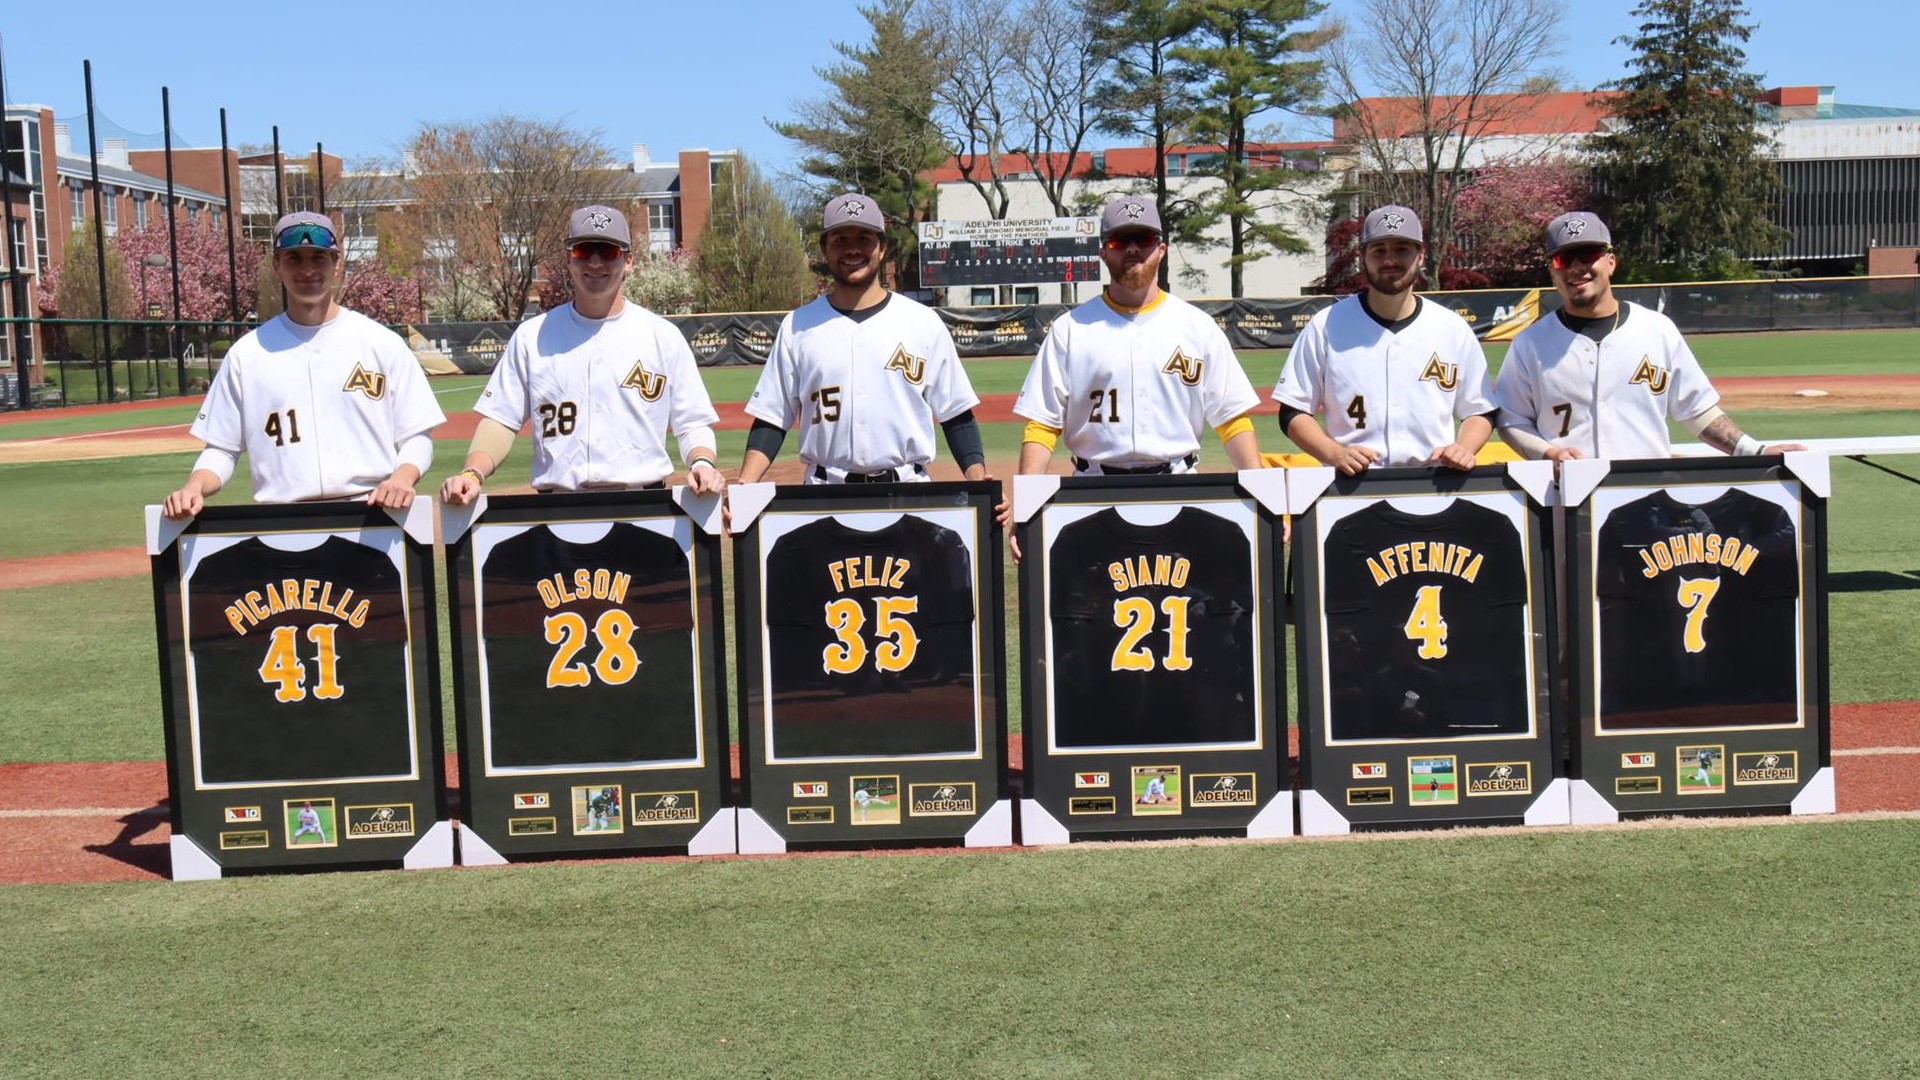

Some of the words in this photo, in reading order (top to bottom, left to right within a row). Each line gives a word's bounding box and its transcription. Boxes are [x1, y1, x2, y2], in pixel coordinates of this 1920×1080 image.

[965, 220, 1001, 228] ADELPHI
[1003, 219, 1052, 227] UNIVERSITY
[1029, 238, 1047, 246] OUT
[970, 240, 991, 248] BALL
[995, 239, 1024, 247] STRIKE
[467, 344, 508, 353] SAMBITO
[995, 327, 1025, 335] CLARK
[342, 361, 386, 401] AU
[620, 359, 667, 402] AU
[885, 342, 927, 386] AU
[1162, 345, 1205, 386] AU
[1418, 351, 1459, 392] AU
[1629, 354, 1670, 395] AU
[539, 400, 577, 438] 28
[1088, 388, 1121, 423] 21
[1347, 394, 1367, 429] 4
[1552, 402, 1573, 437] 7
[264, 408, 301, 447] 41
[828, 555, 911, 593] FELIZ
[1108, 554, 1191, 592] SIANO
[1366, 541, 1484, 587] AFFENITA
[1639, 532, 1760, 579] JOHNSON
[224, 578, 371, 636] PICARELLO
[536, 568, 631, 609] OLSON
[1403, 585, 1448, 659] 4
[1677, 575, 1721, 653] 7
[543, 608, 642, 689] 28
[822, 595, 921, 675] 35
[1111, 595, 1193, 672] 21
[258, 623, 344, 703] 41
[1471, 778, 1527, 792] ADELPHI
[1737, 767, 1794, 781] ADELPHI
[636, 808, 695, 822] ADELPHI
[914, 799, 972, 813] ADELPHI
[1194, 789, 1252, 804] ADELPHI
[350, 820, 410, 836] ADELPHI
